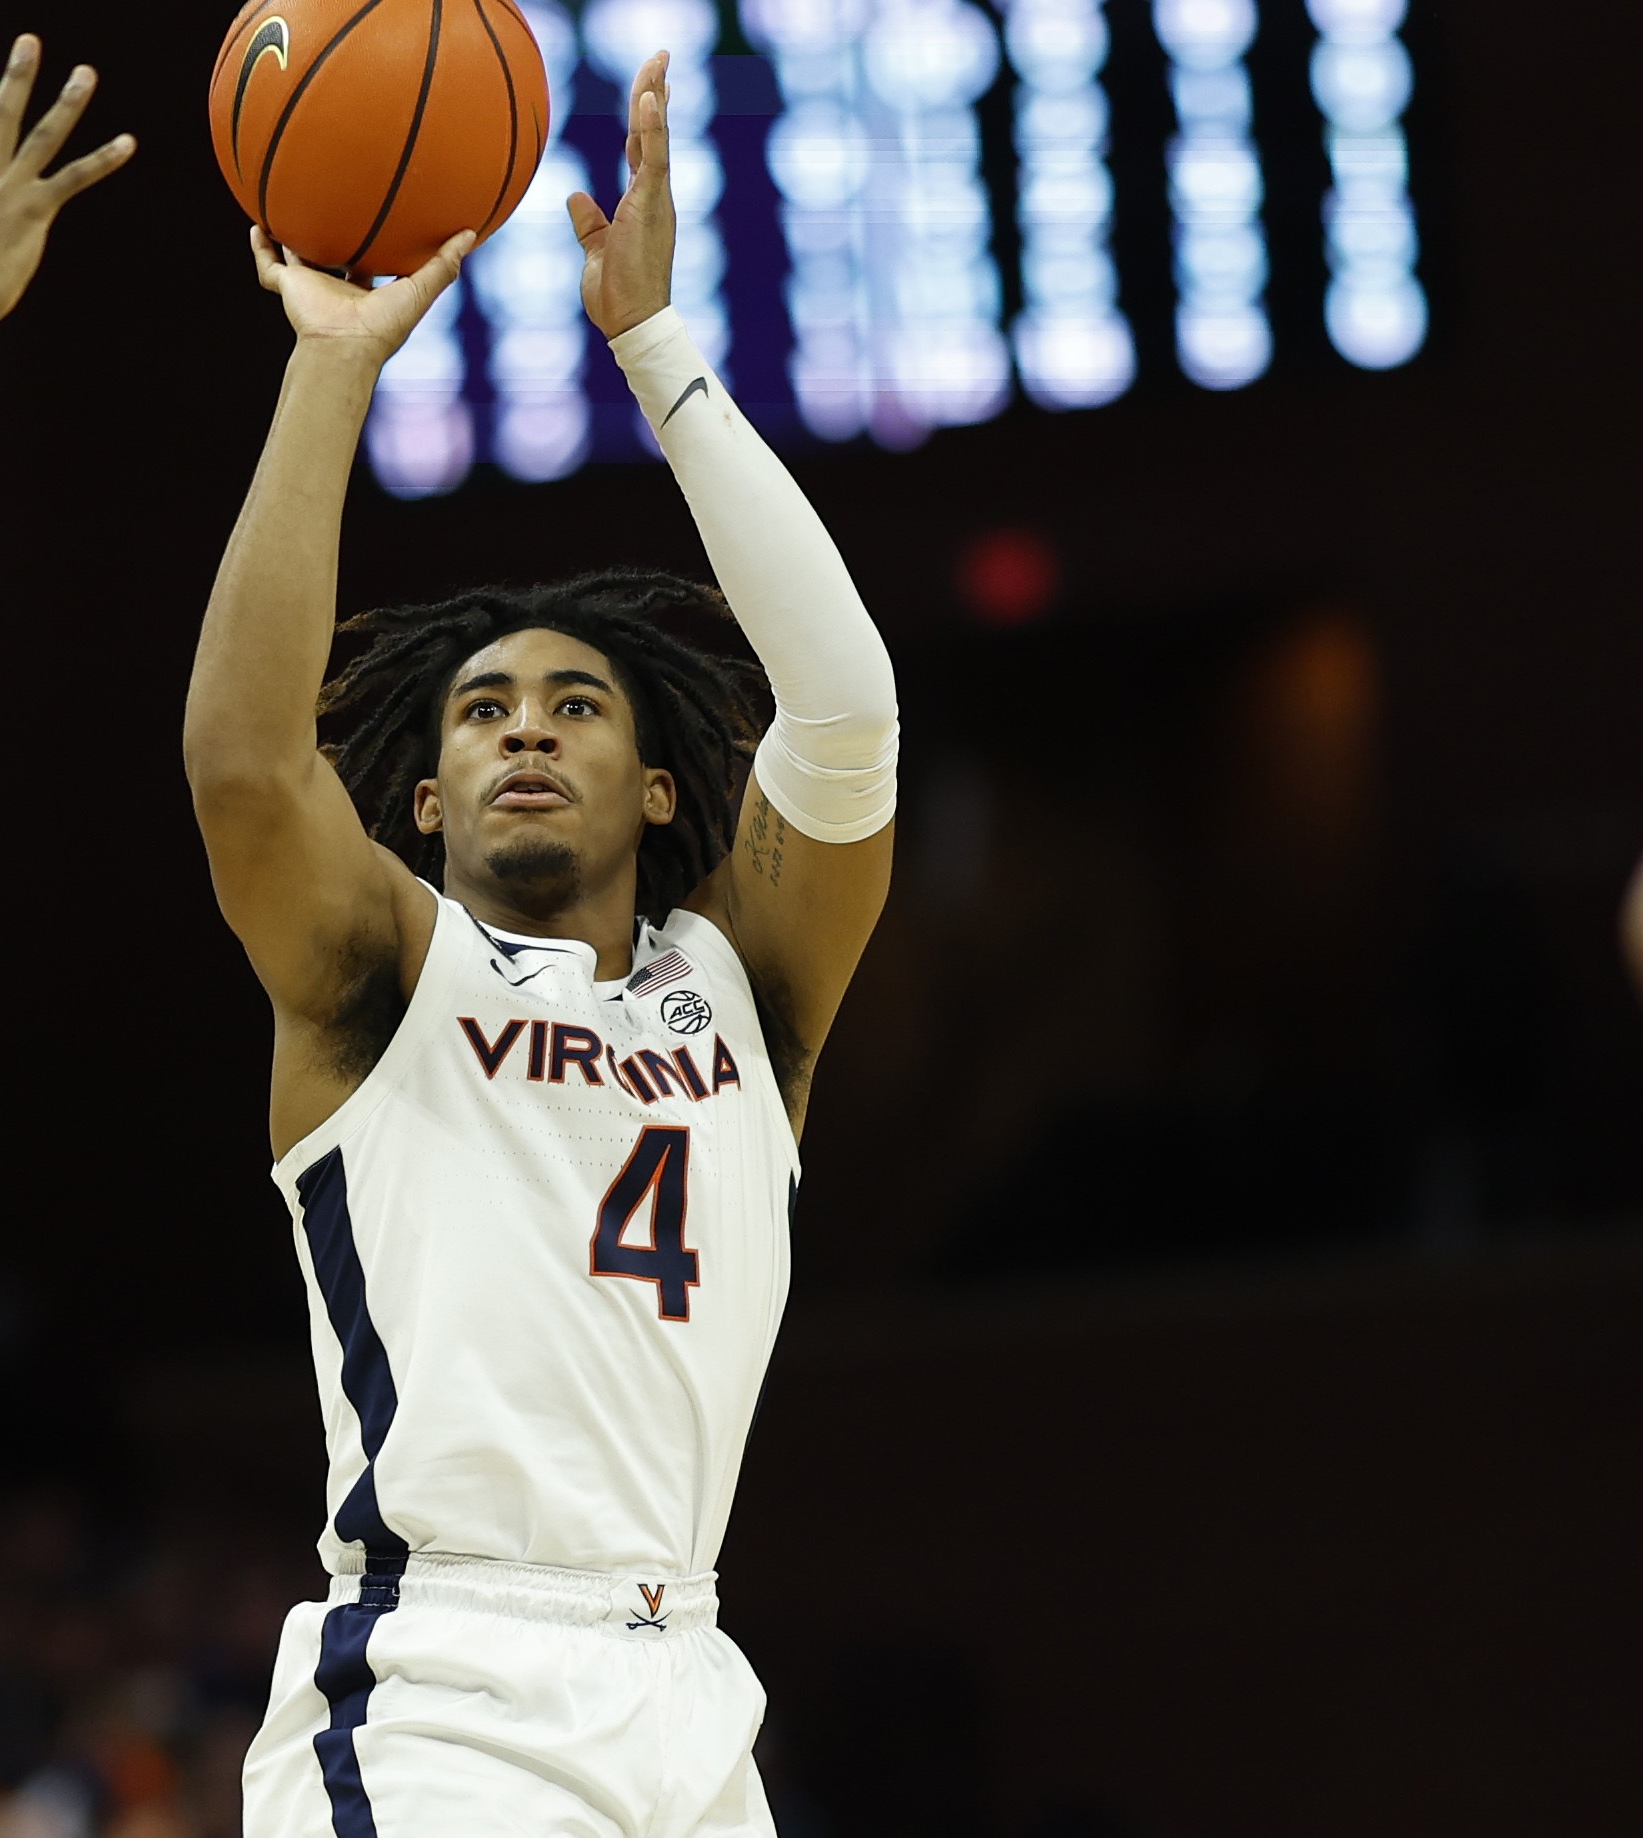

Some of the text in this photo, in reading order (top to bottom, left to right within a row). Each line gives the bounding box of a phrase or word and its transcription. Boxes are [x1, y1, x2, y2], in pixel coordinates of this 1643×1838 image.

[669, 998, 705, 1020] ACC
[589, 1126, 700, 1323] 4
[637, 1583, 666, 1619] V
